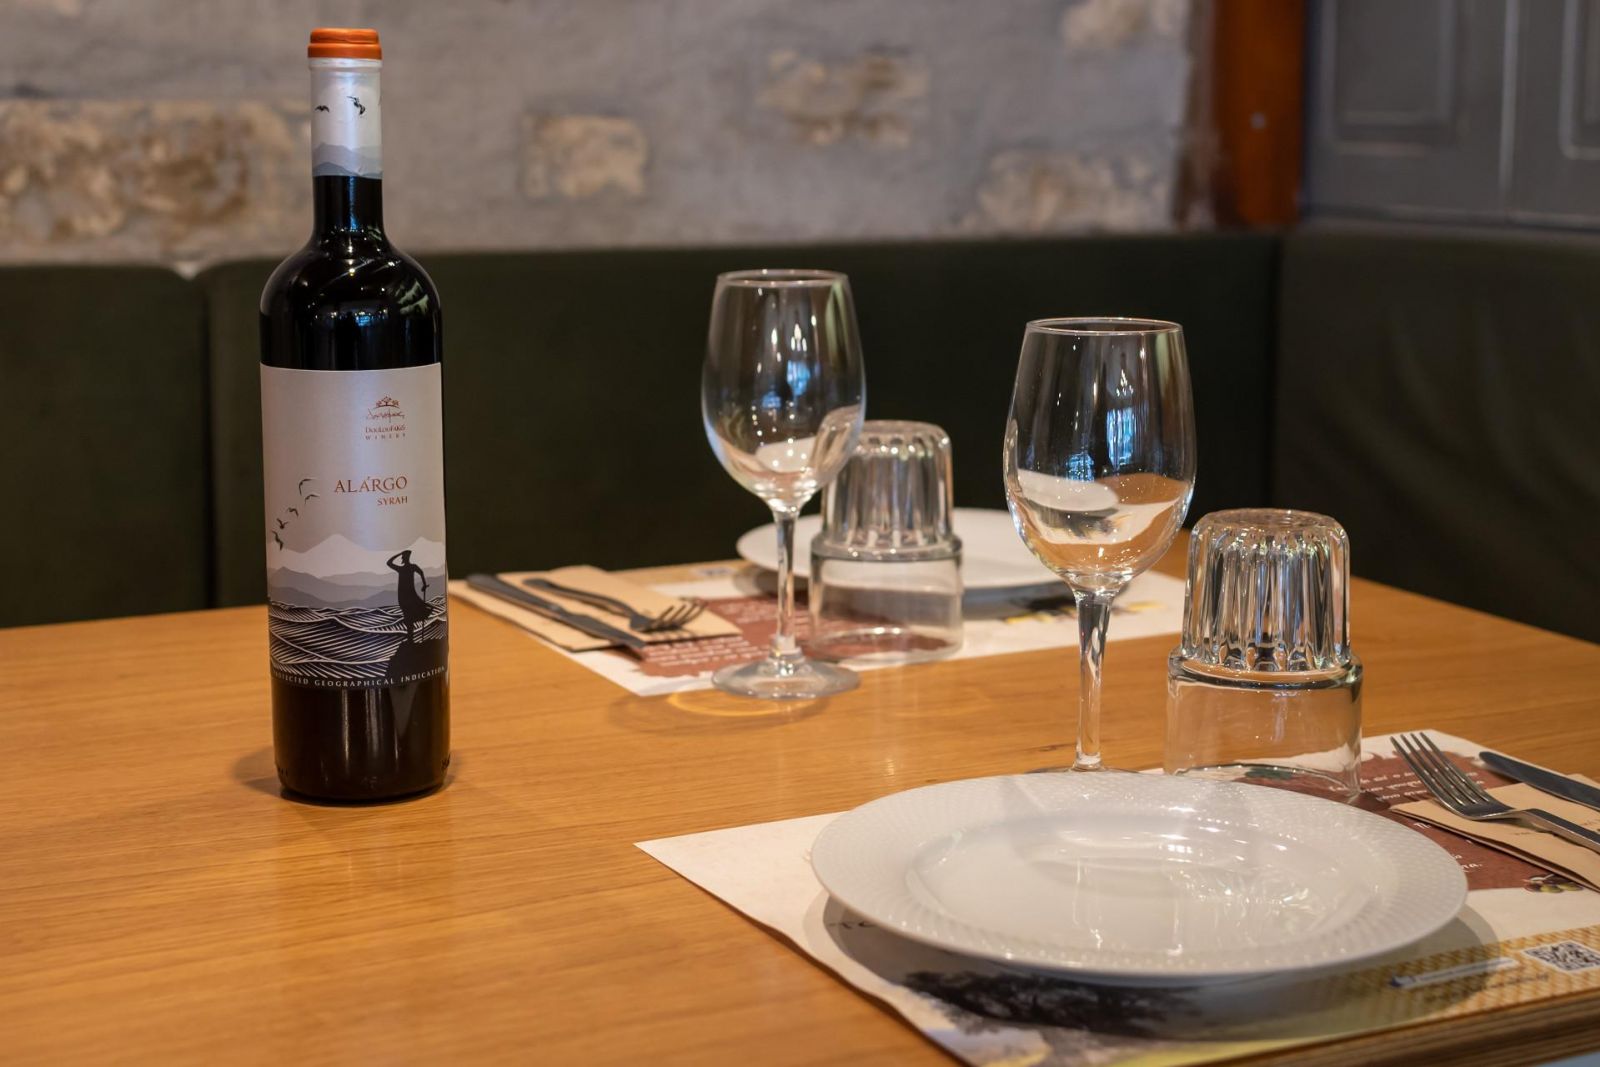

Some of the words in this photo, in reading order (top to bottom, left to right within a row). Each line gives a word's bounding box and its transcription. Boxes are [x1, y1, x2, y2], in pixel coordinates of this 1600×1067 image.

[334, 476, 408, 494] ALÁRGO
[377, 496, 408, 506] SYRAH
[314, 677, 395, 688] GEOGRAPHICAL
